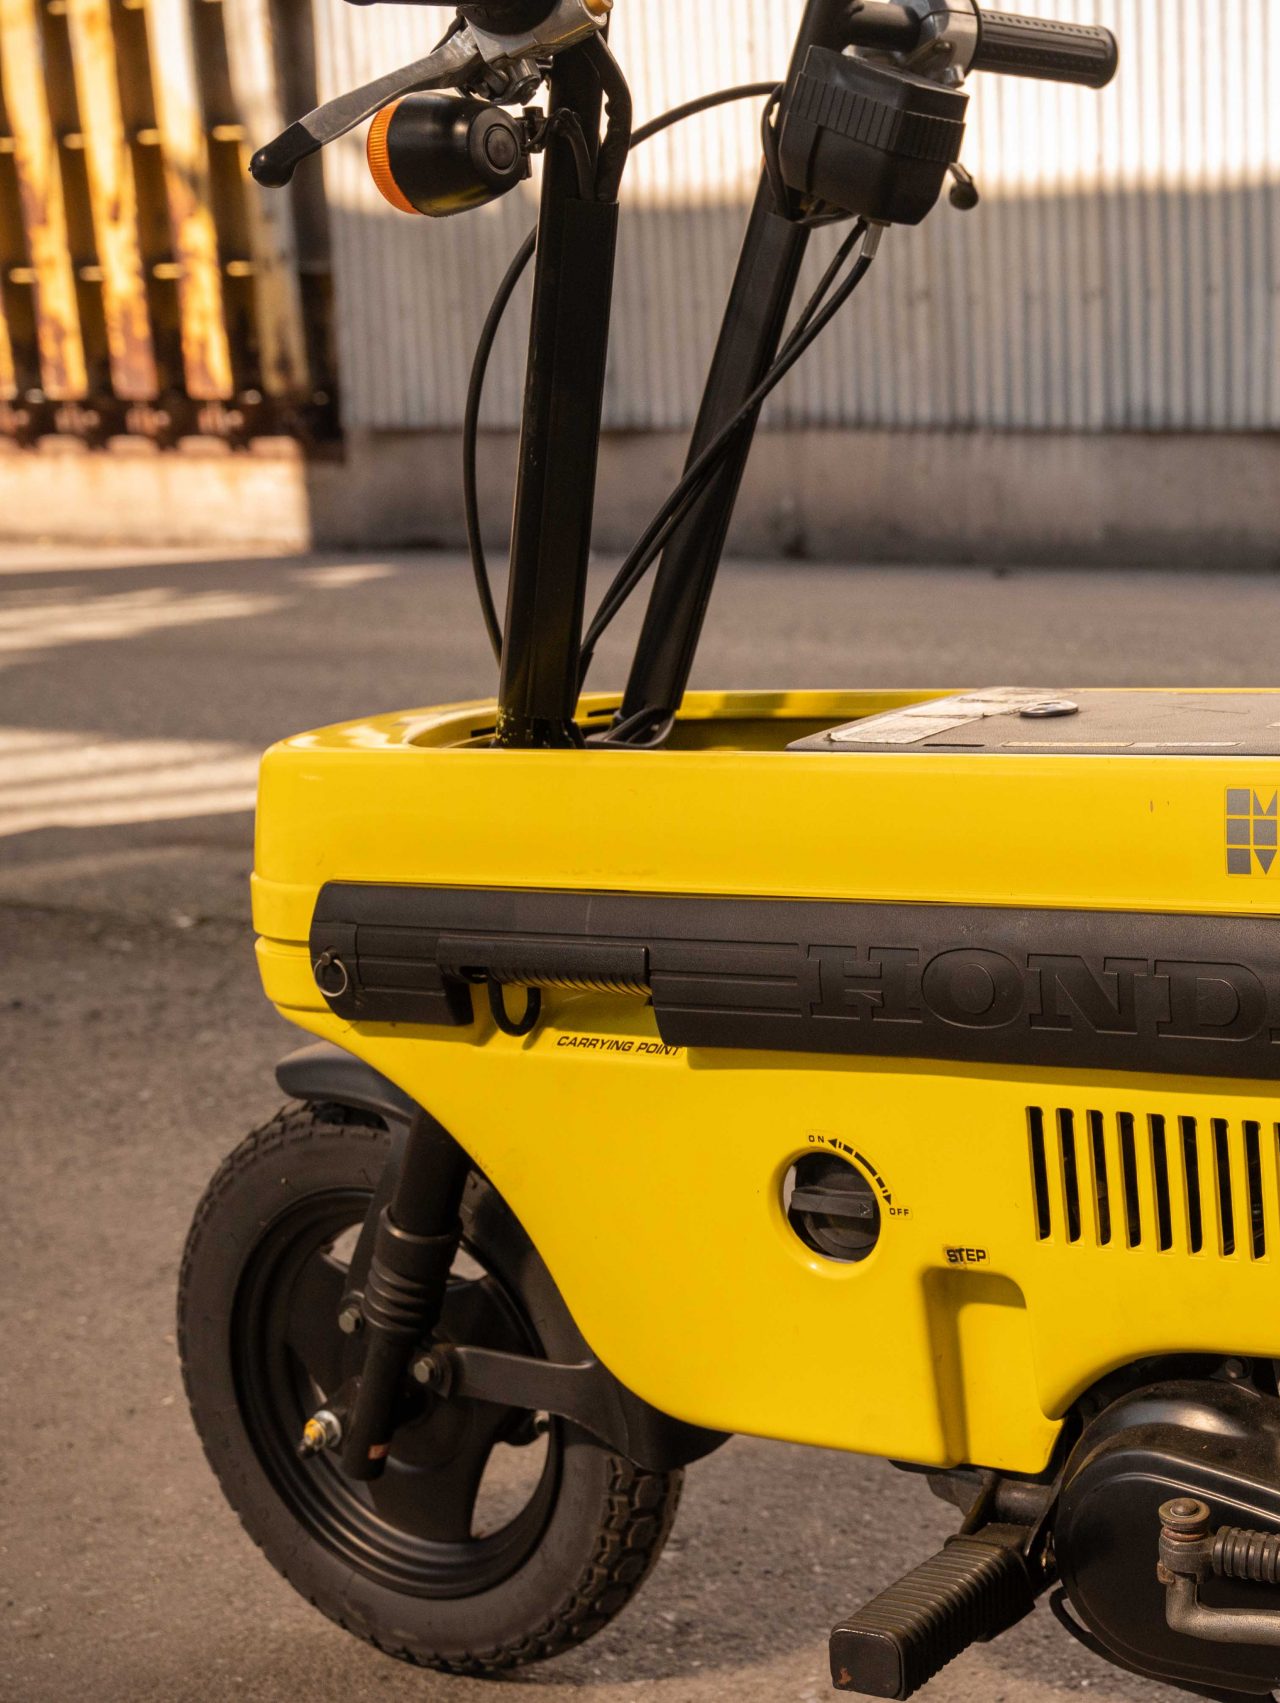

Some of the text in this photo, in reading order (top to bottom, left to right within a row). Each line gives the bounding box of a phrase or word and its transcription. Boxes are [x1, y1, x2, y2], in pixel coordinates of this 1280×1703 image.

[557, 1036, 682, 1056] CARRYING POINT
[808, 1135, 825, 1143] ON
[889, 1207, 909, 1217] OFF
[946, 1248, 986, 1263] STEP
